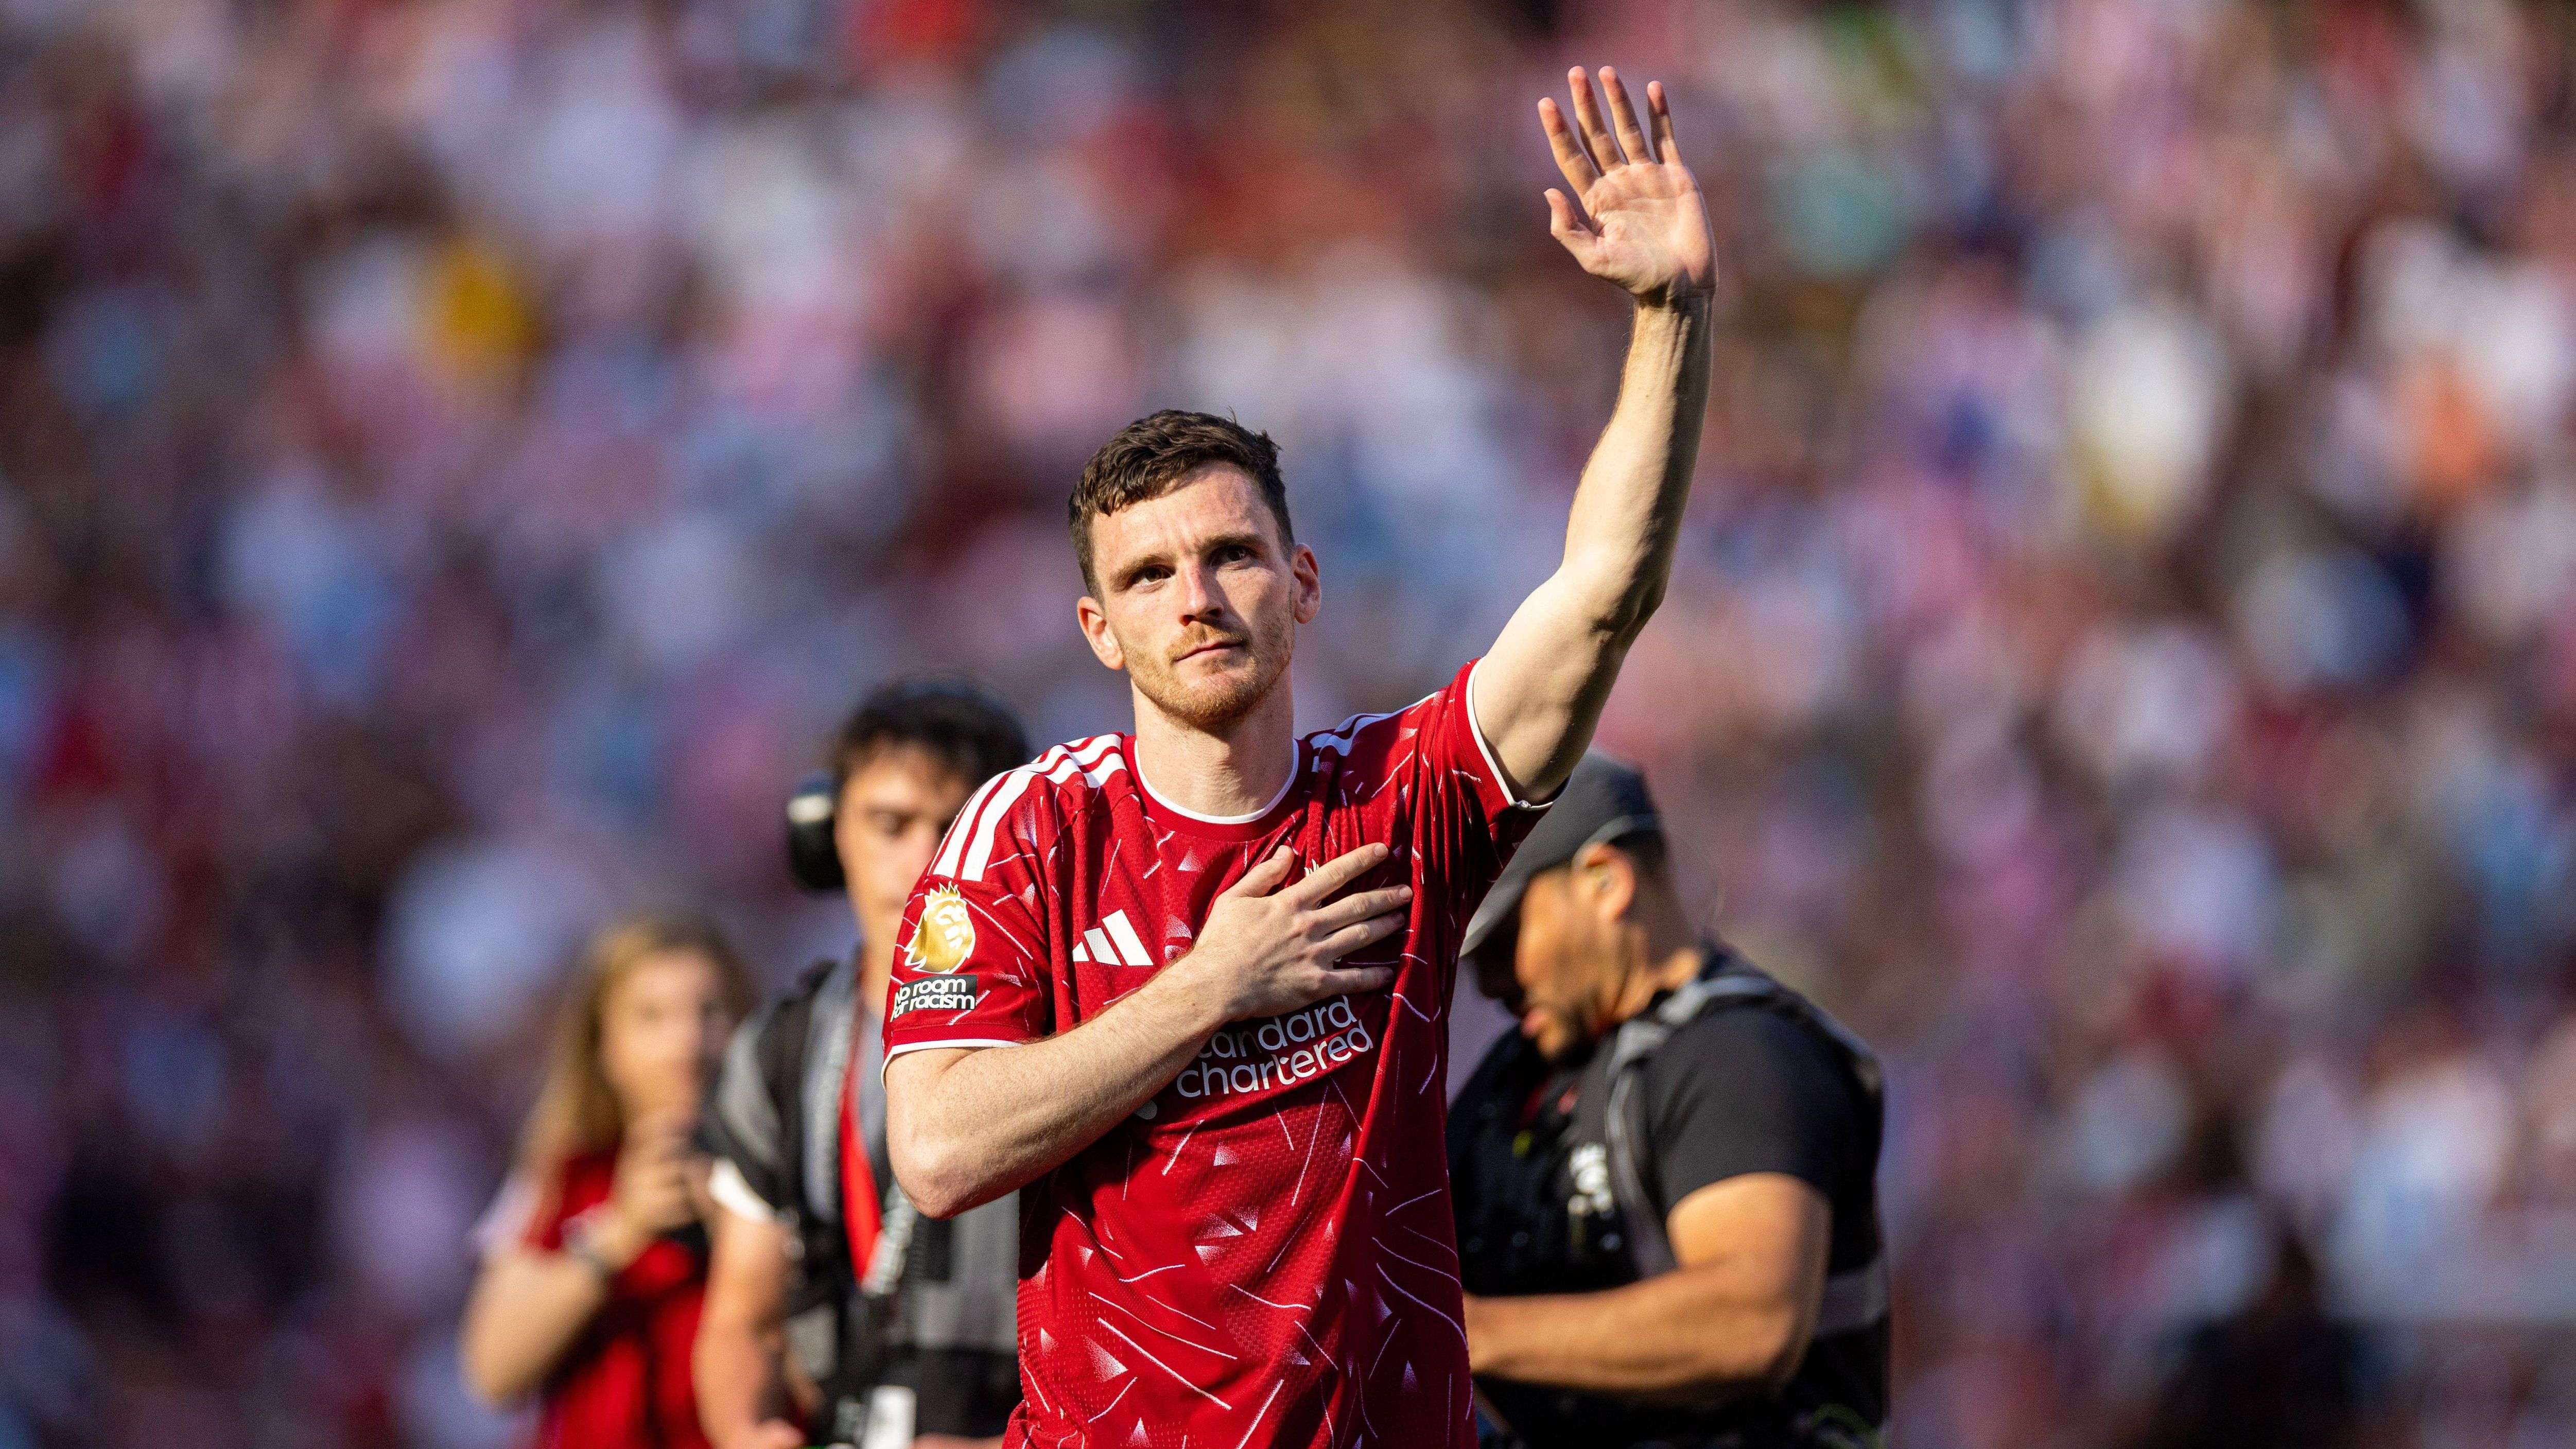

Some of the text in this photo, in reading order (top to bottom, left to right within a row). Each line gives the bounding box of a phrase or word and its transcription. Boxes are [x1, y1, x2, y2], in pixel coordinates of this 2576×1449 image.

[909, 990, 975, 1011] racism
[912, 978, 966, 997] room
[1198, 994, 1357, 1058] andard
[1177, 1019, 1373, 1097] chartered
